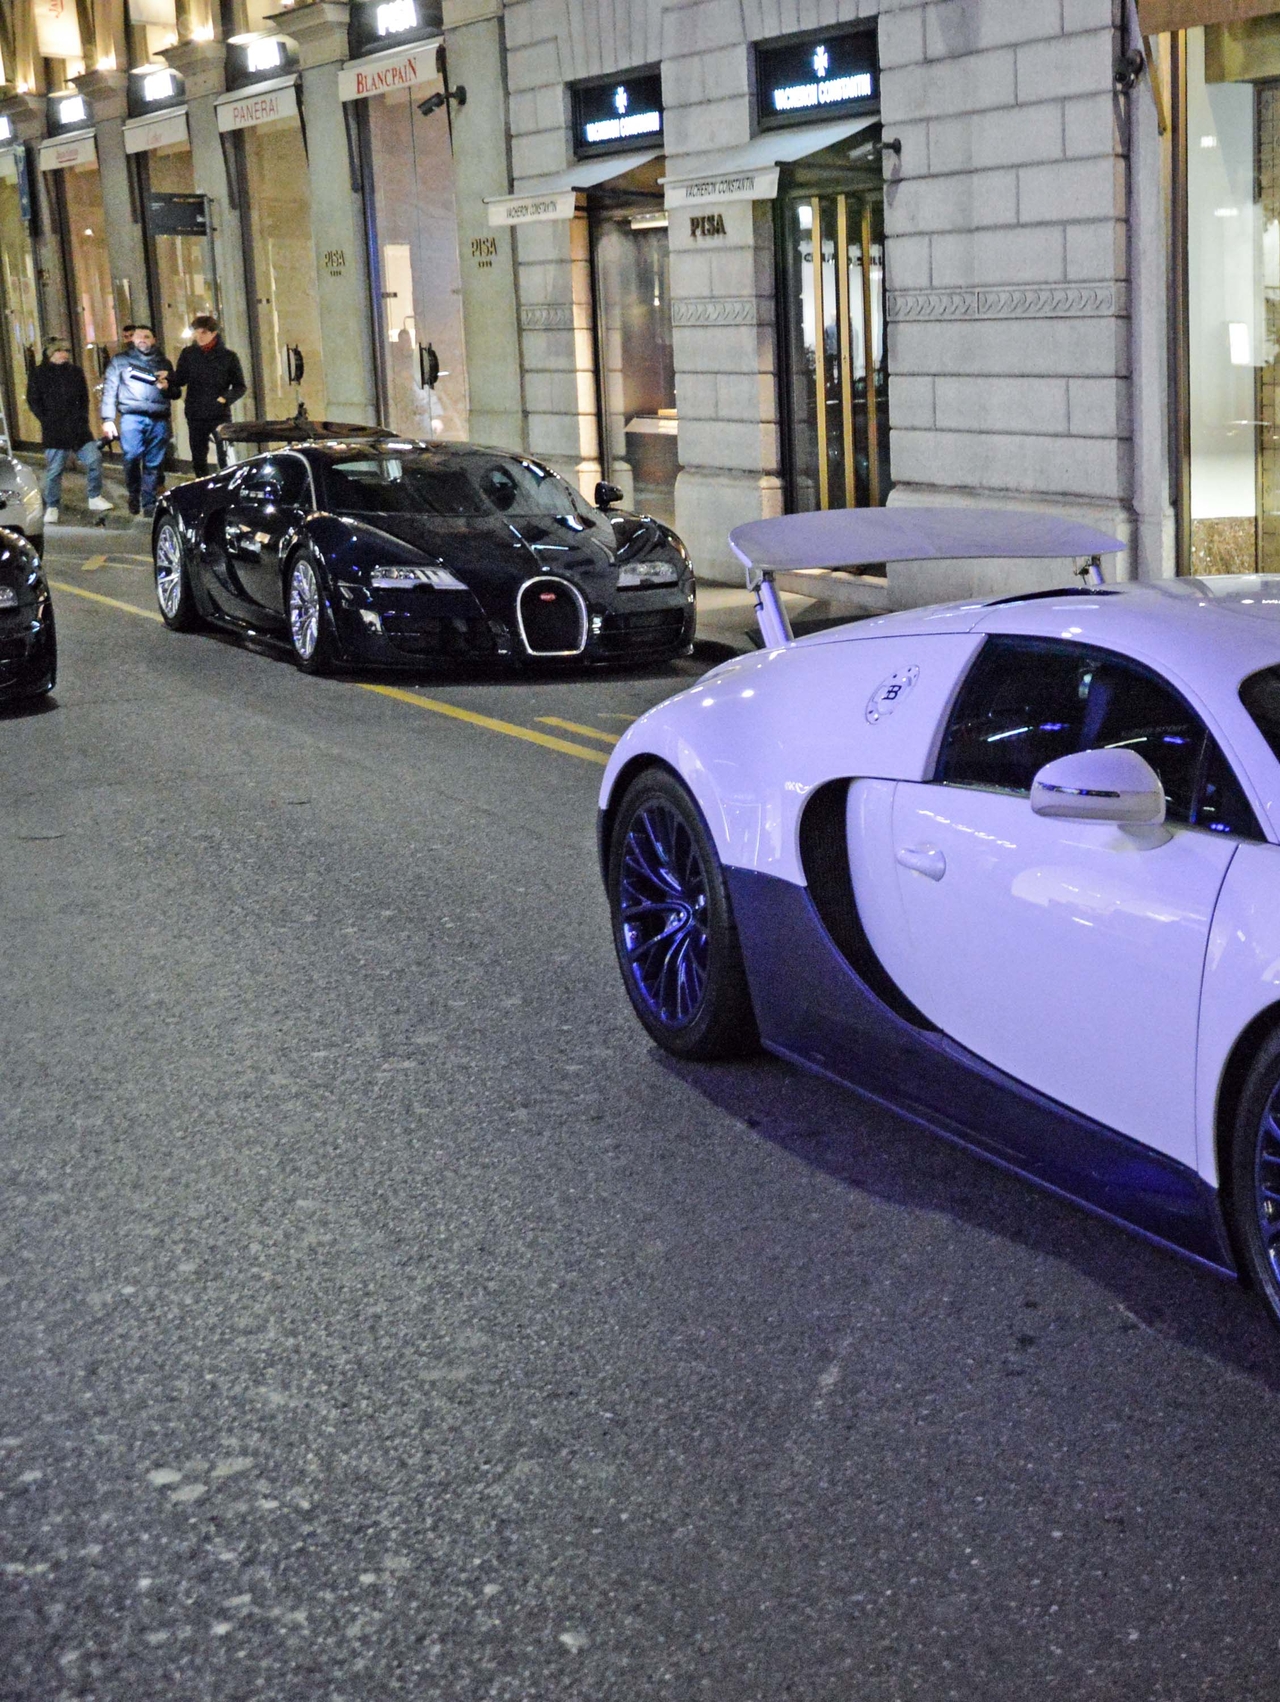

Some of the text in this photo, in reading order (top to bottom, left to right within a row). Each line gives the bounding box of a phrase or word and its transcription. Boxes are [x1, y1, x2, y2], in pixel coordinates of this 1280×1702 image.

[355, 58, 418, 95] BLANCPAIN
[232, 97, 279, 125] PANERAI
[685, 176, 755, 198] VACHERON CONSTANTIN
[689, 213, 727, 238] PISA
[324, 249, 346, 267] PISA
[471, 236, 498, 257] PISA
